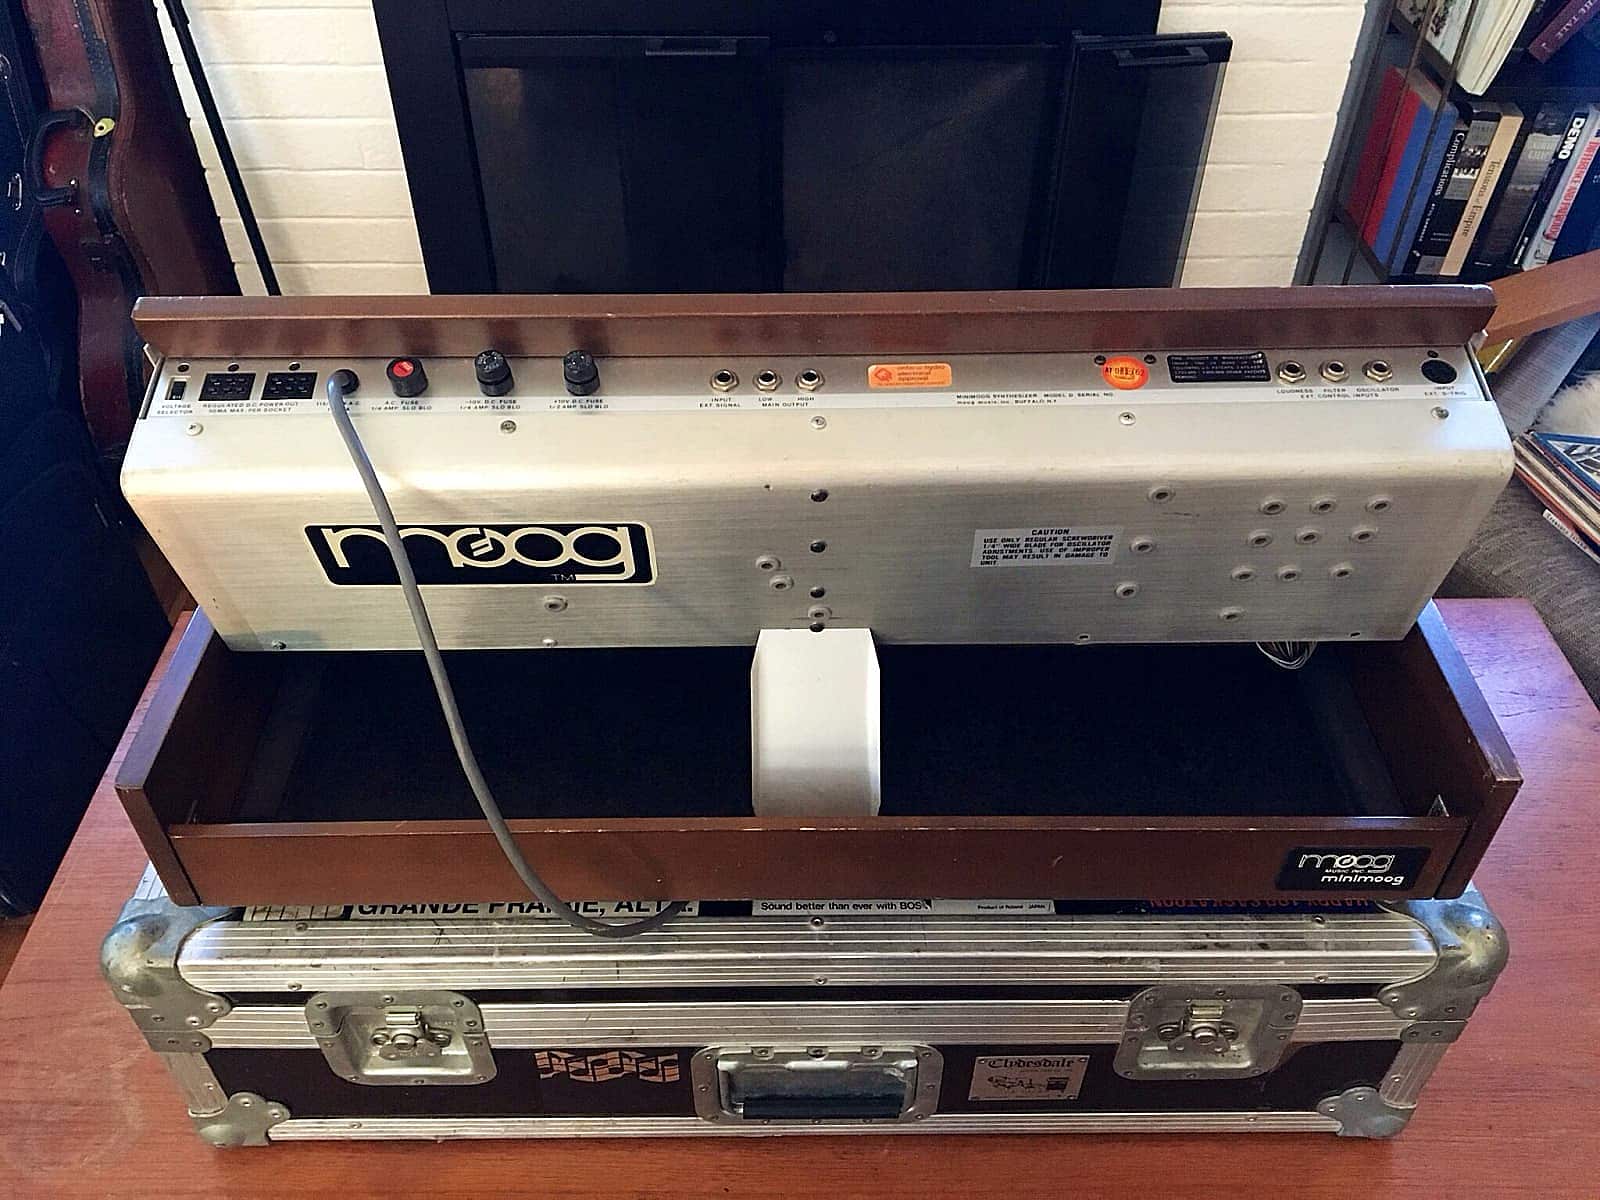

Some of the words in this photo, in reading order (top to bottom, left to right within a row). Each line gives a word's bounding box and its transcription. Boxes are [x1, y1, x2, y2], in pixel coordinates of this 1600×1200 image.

[1434, 132, 1465, 196] Complications
[1462, 205, 1483, 237] Empire
[1031, 528, 1071, 536] CAUTION
[321, 526, 636, 581] moog
[1298, 854, 1396, 873] moog
[1320, 874, 1405, 886] minimoog
[488, 901, 605, 917] PRAIE,
[761, 902, 793, 911] Sound
[795, 902, 826, 910] better
[829, 902, 850, 910] than
[876, 902, 897, 910] with
[987, 1058, 1075, 1069] Clydesdale
